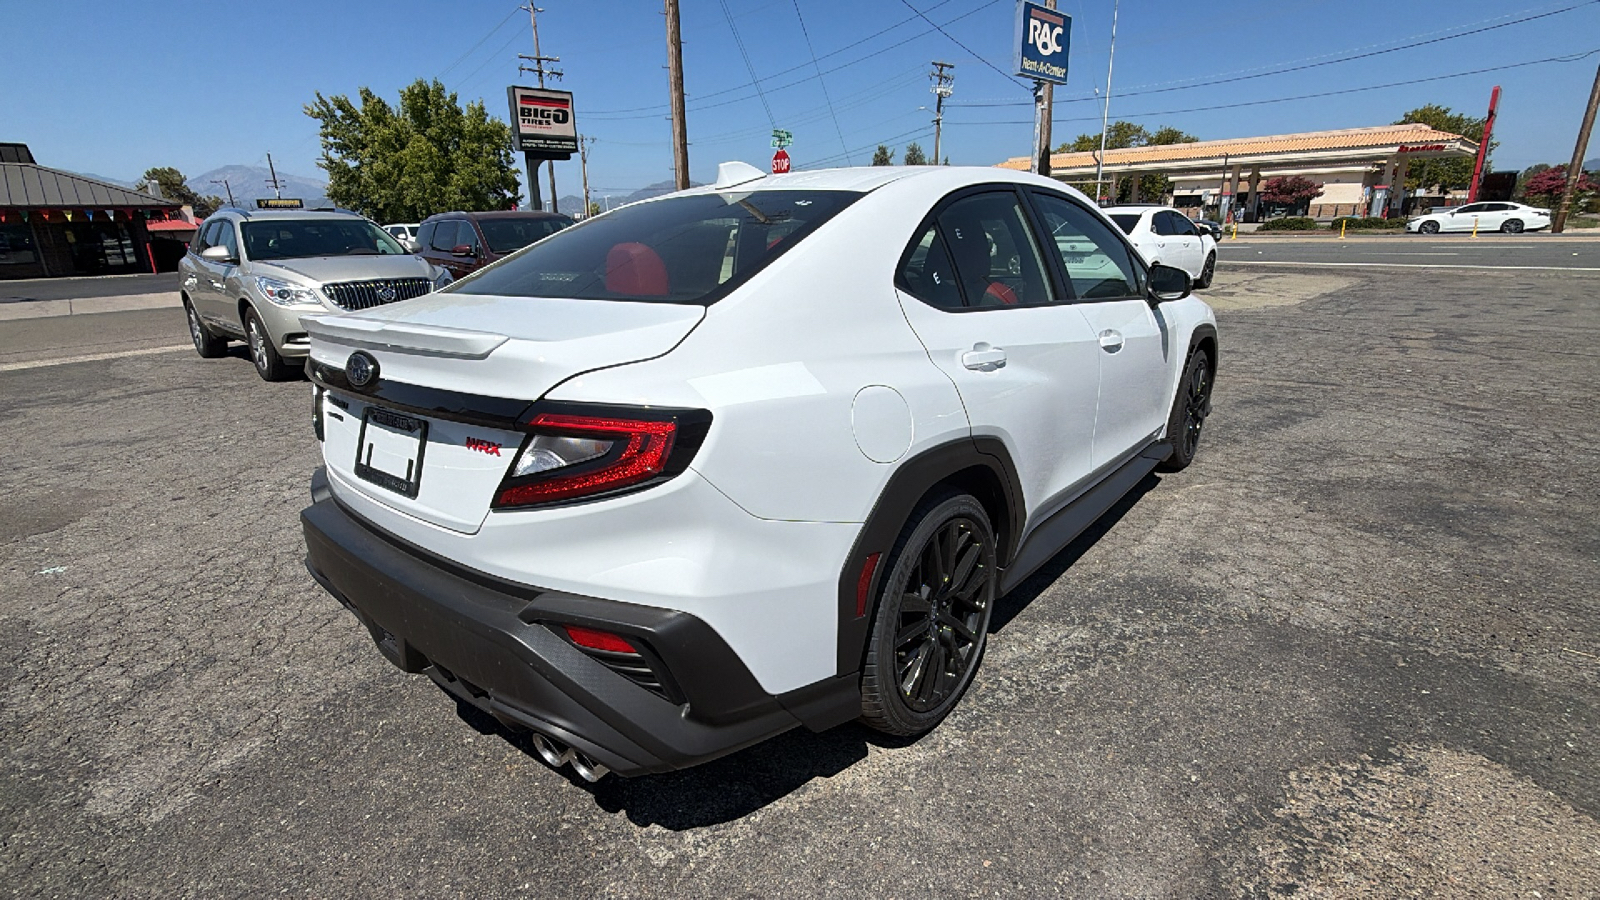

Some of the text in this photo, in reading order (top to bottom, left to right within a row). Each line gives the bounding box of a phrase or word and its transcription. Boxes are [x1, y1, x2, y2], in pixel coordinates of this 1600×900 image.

[1028, 18, 1063, 56] RAC
[520, 107, 569, 124] BIG O
[520, 118, 552, 126] TIRES
[772, 158, 789, 171] STOP
[466, 436, 503, 457] WRX
